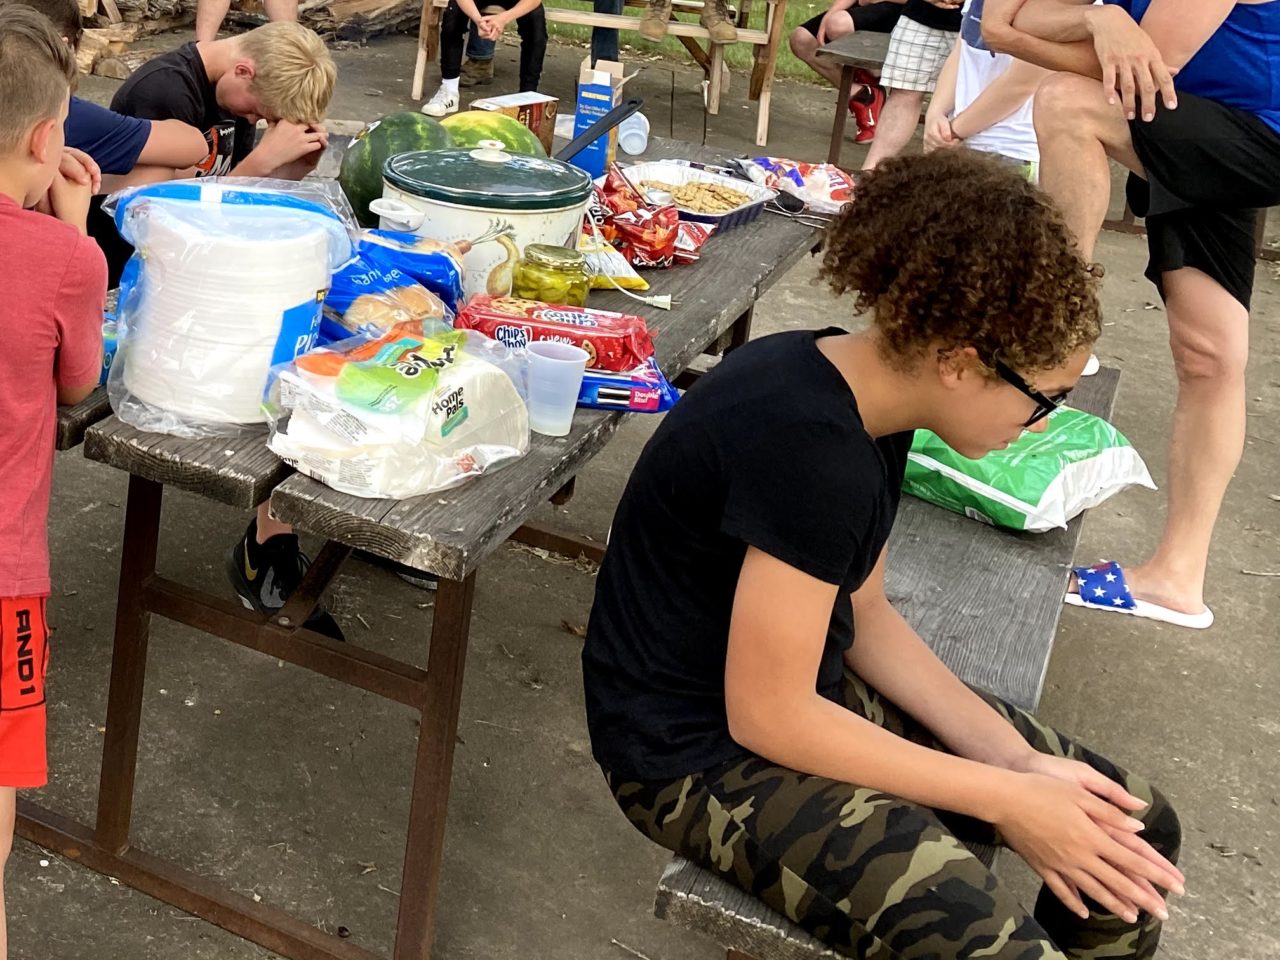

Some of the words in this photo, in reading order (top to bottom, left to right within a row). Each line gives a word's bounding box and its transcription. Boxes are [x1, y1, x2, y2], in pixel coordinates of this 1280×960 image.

[496, 326, 526, 341] Chips
[432, 386, 464, 415] Home
[634, 390, 659, 400] Double
[445, 398, 464, 419] Pals
